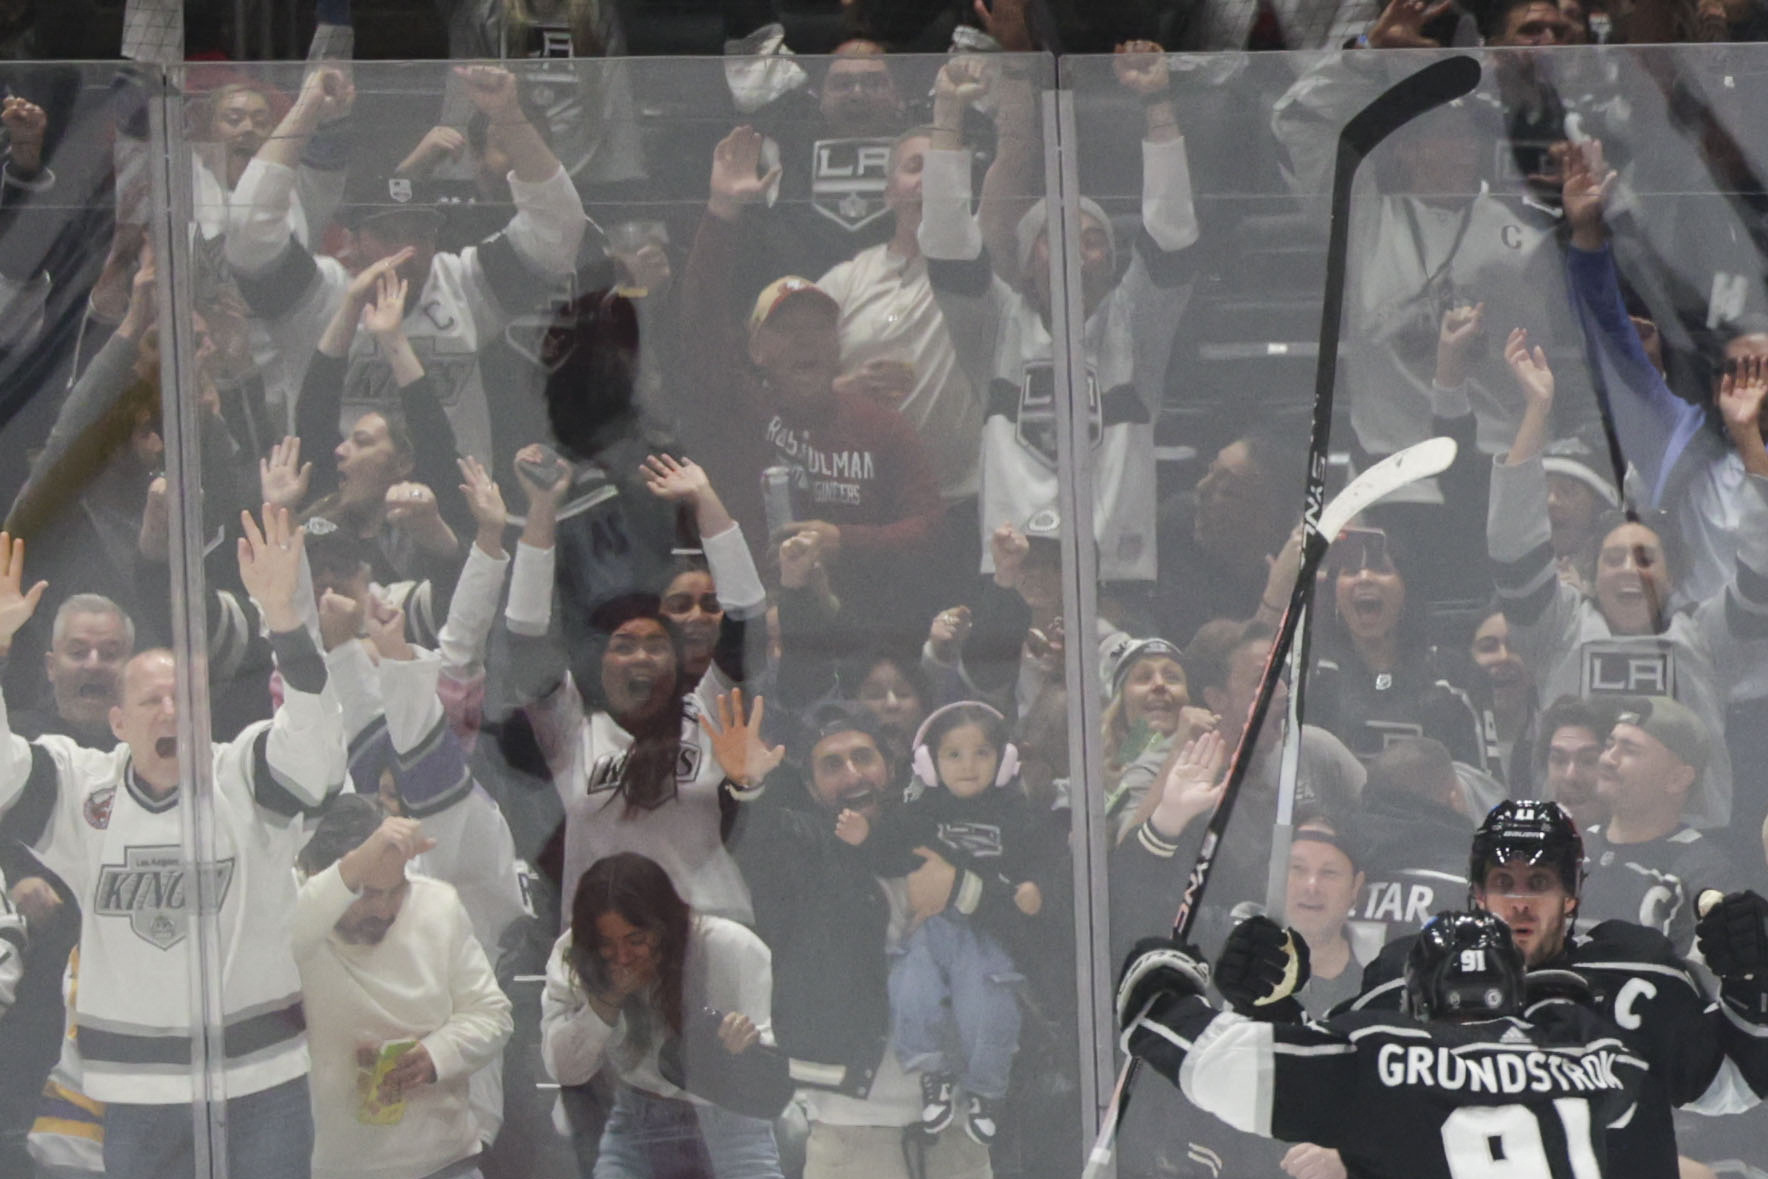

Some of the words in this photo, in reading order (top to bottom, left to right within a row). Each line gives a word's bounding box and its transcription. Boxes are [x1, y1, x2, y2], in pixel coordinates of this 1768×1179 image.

[819, 147, 890, 176] LA
[1501, 224, 1522, 249] C
[1591, 658, 1664, 691] LA
[100, 869, 224, 911] KING
[1348, 881, 1435, 923] TAR
[1460, 949, 1487, 973] 91
[1614, 977, 1657, 1030] C
